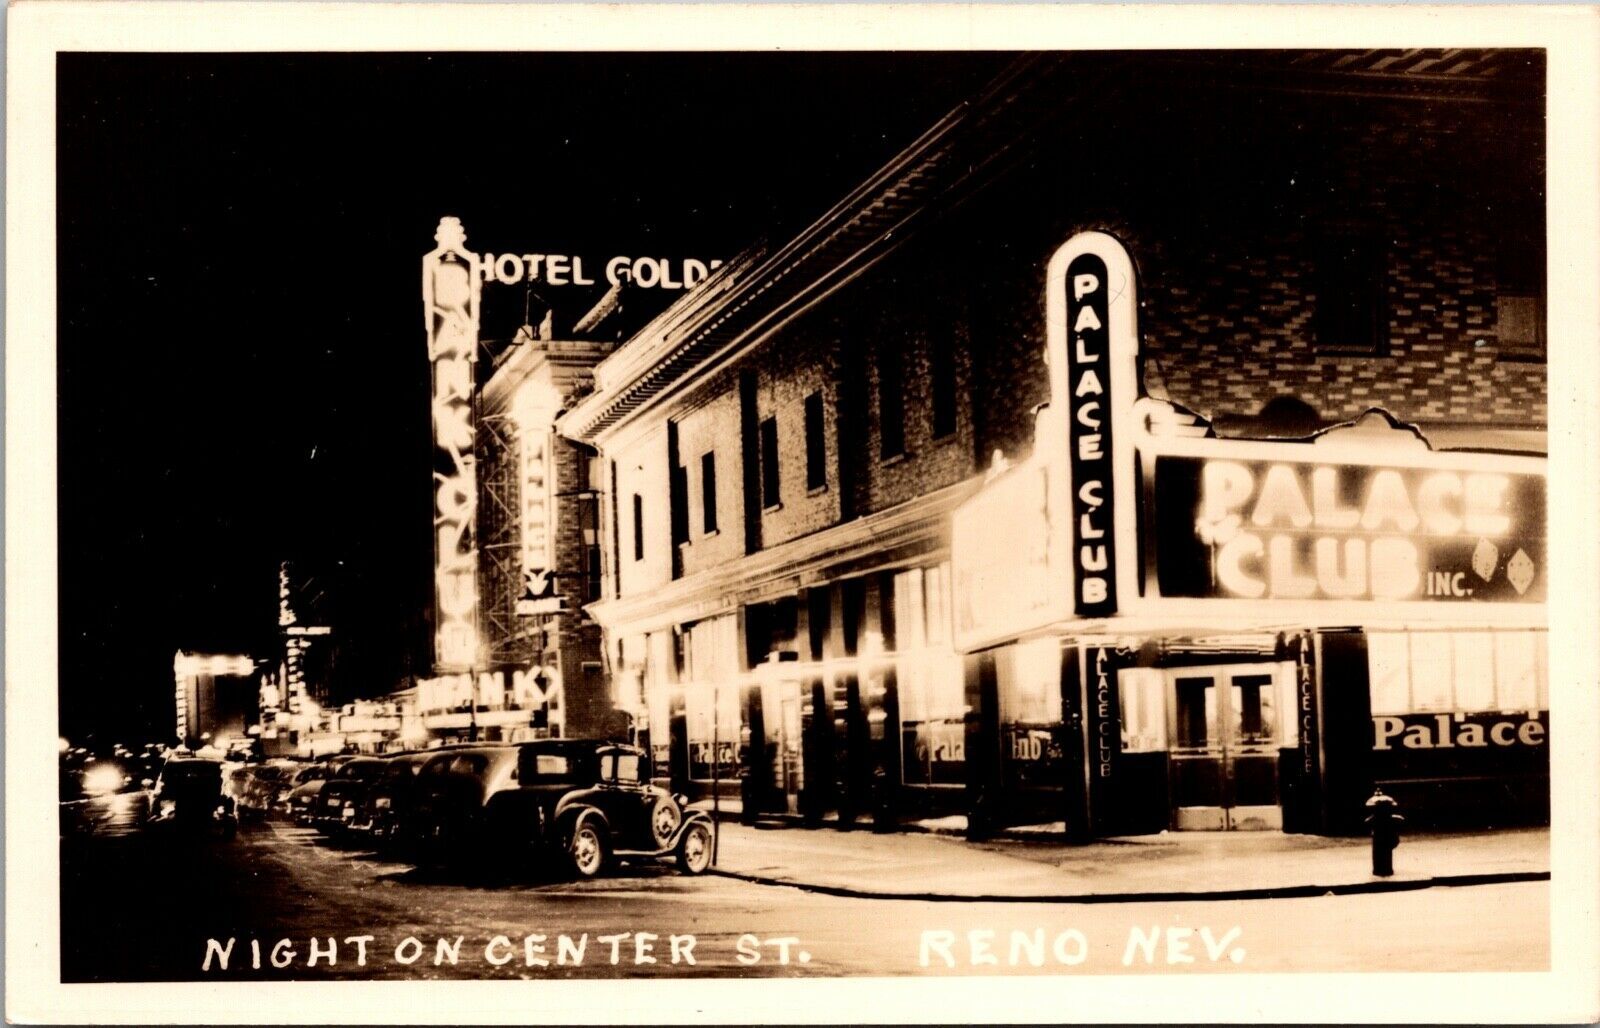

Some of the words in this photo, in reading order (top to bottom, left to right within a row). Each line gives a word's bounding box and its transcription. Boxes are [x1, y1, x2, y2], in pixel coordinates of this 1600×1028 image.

[477, 253, 595, 286] HOTEL
[605, 255, 722, 290] GOLD
[1073, 273, 1103, 461] PALACE
[1202, 461, 1511, 535] PALACE
[1078, 480, 1108, 605] CLUB
[1216, 533, 1421, 600] CLUB
[1427, 571, 1474, 598] INC.
[1096, 645, 1109, 718] ALACE
[1300, 636, 1312, 712] ALACE
[1100, 721, 1111, 778] CLUB
[1371, 715, 1545, 751] Palace
